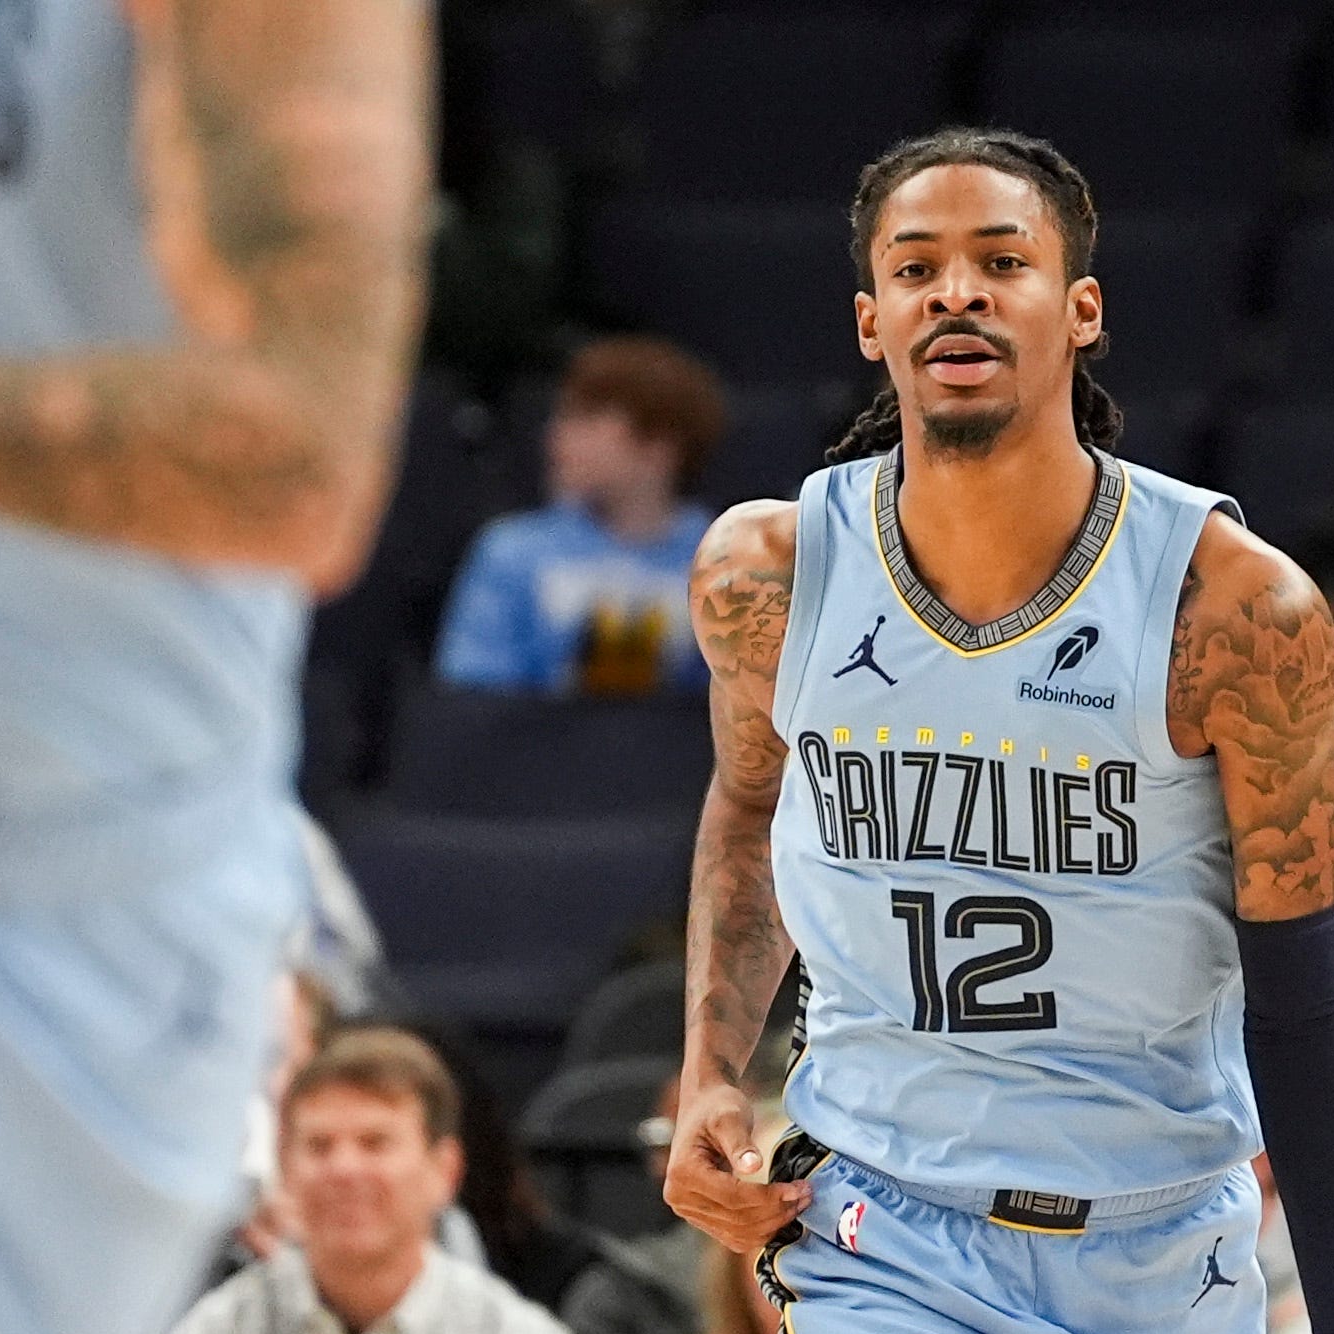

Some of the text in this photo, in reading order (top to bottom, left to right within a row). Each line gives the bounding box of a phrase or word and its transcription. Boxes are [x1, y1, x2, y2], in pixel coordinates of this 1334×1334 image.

[1020, 682, 1115, 710] Robinhood
[832, 726, 1091, 771] MEMPHIS
[797, 730, 1138, 875] GRIZZLIES
[891, 888, 1057, 1033] 12
